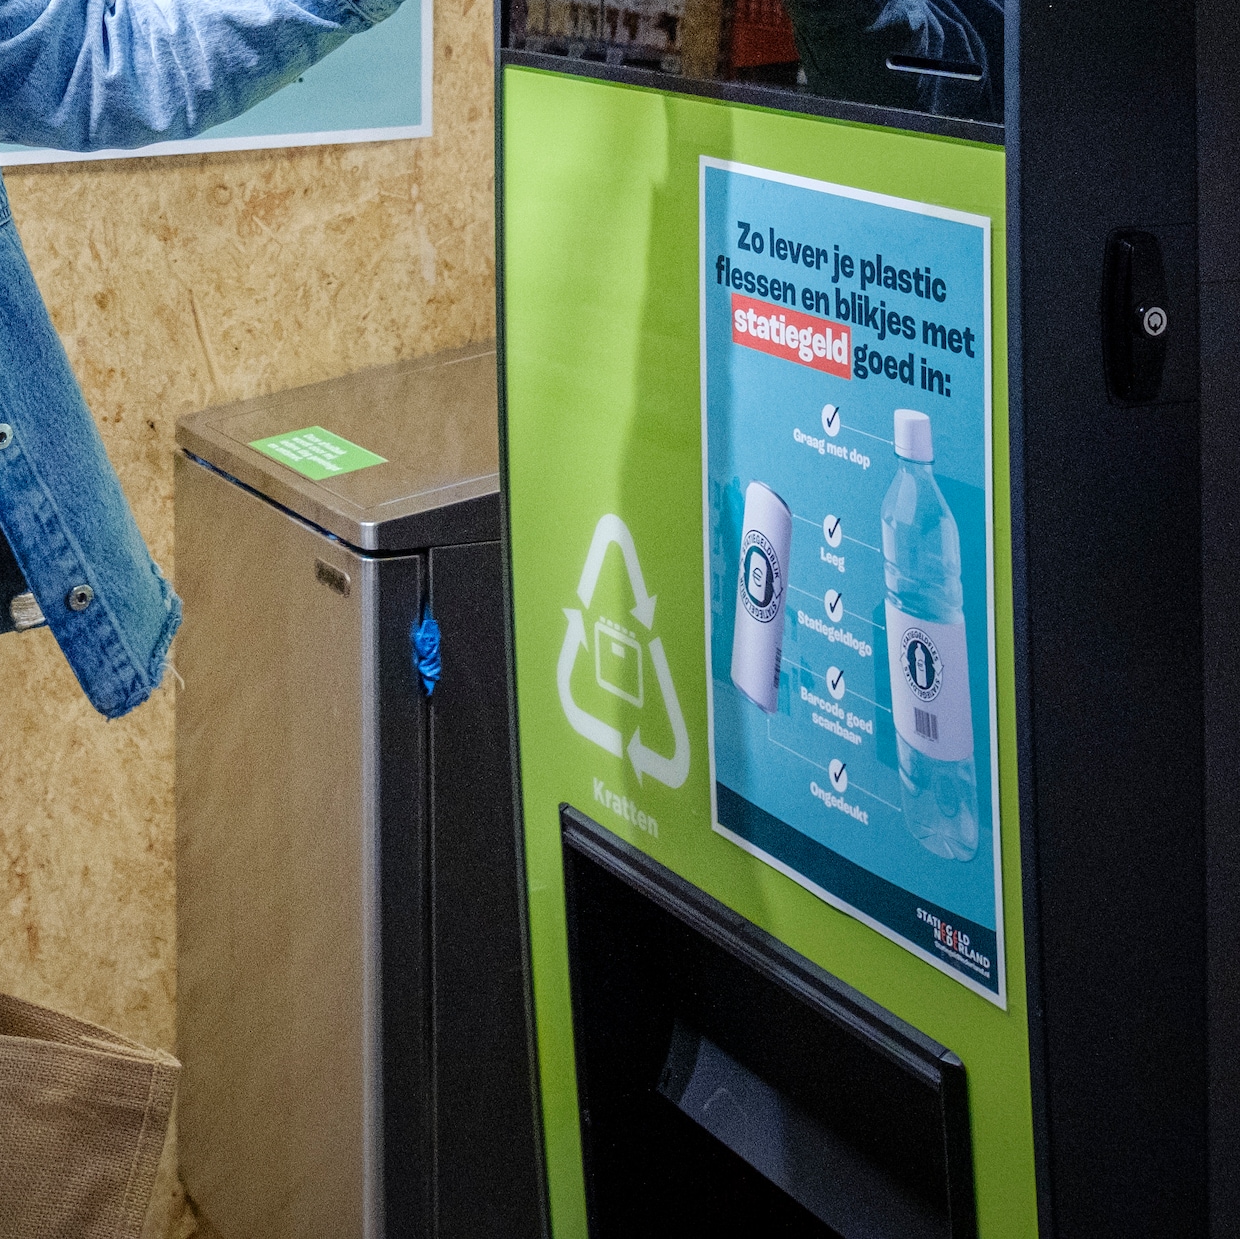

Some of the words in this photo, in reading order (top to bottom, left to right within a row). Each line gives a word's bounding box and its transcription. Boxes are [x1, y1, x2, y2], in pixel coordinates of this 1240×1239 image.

[736, 220, 765, 254] Zo
[769, 227, 828, 271] lever
[830, 244, 855, 284] je
[859, 254, 947, 303] plastic
[715, 254, 796, 306] flessen
[801, 285, 830, 317] en
[834, 287, 916, 341] blikjes
[922, 318, 976, 358] met
[734, 307, 849, 365] statiegeld
[853, 343, 915, 386] goed
[920, 360, 952, 398] in:
[793, 427, 826, 456] Graag
[826, 442, 849, 461] met
[849, 447, 871, 471] dop
[820, 547, 845, 573] Leeg
[797, 609, 873, 658] Statiegeldlogo
[800, 685, 845, 720] Barcode
[846, 711, 873, 736] goed
[812, 712, 863, 746] scanbaar
[592, 776, 659, 840] Kratten
[809, 781, 869, 827] Ongedeukt
[916, 907, 971, 946] STATIEGELD
[933, 927, 991, 969] NEDERLAND
